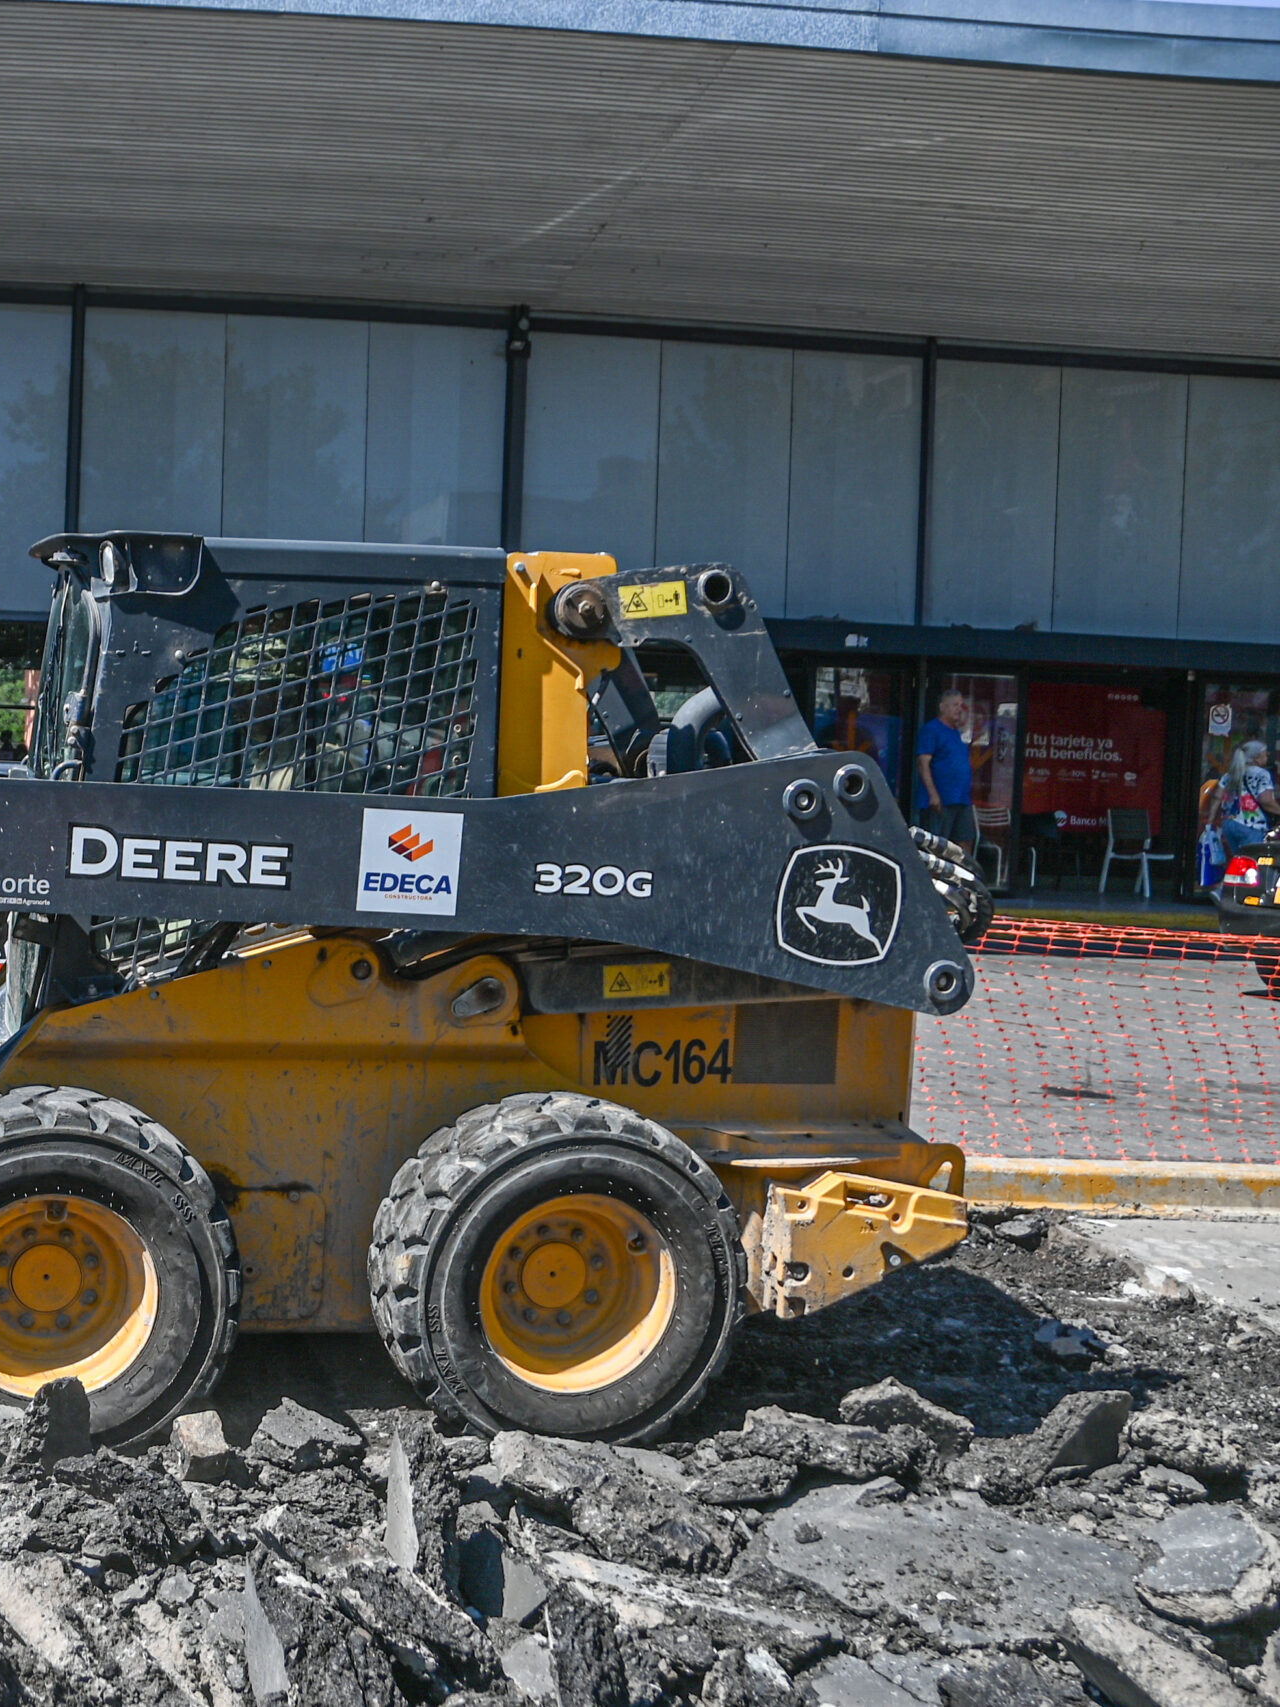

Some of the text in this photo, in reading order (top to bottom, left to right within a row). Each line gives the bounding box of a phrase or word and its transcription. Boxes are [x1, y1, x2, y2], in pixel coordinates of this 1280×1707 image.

[1033, 733, 1047, 745] tu
[1050, 734, 1094, 747] tarjeta
[1097, 738, 1113, 750] ya
[1049, 747, 1123, 762] beneficios.
[1070, 815, 1097, 826] Banco
[70, 826, 290, 888] DEERE
[363, 871, 452, 895] EDECA
[534, 862, 654, 898] 320G
[384, 893, 433, 901] CONSTRUCTORA
[593, 1036, 732, 1087] MC164
